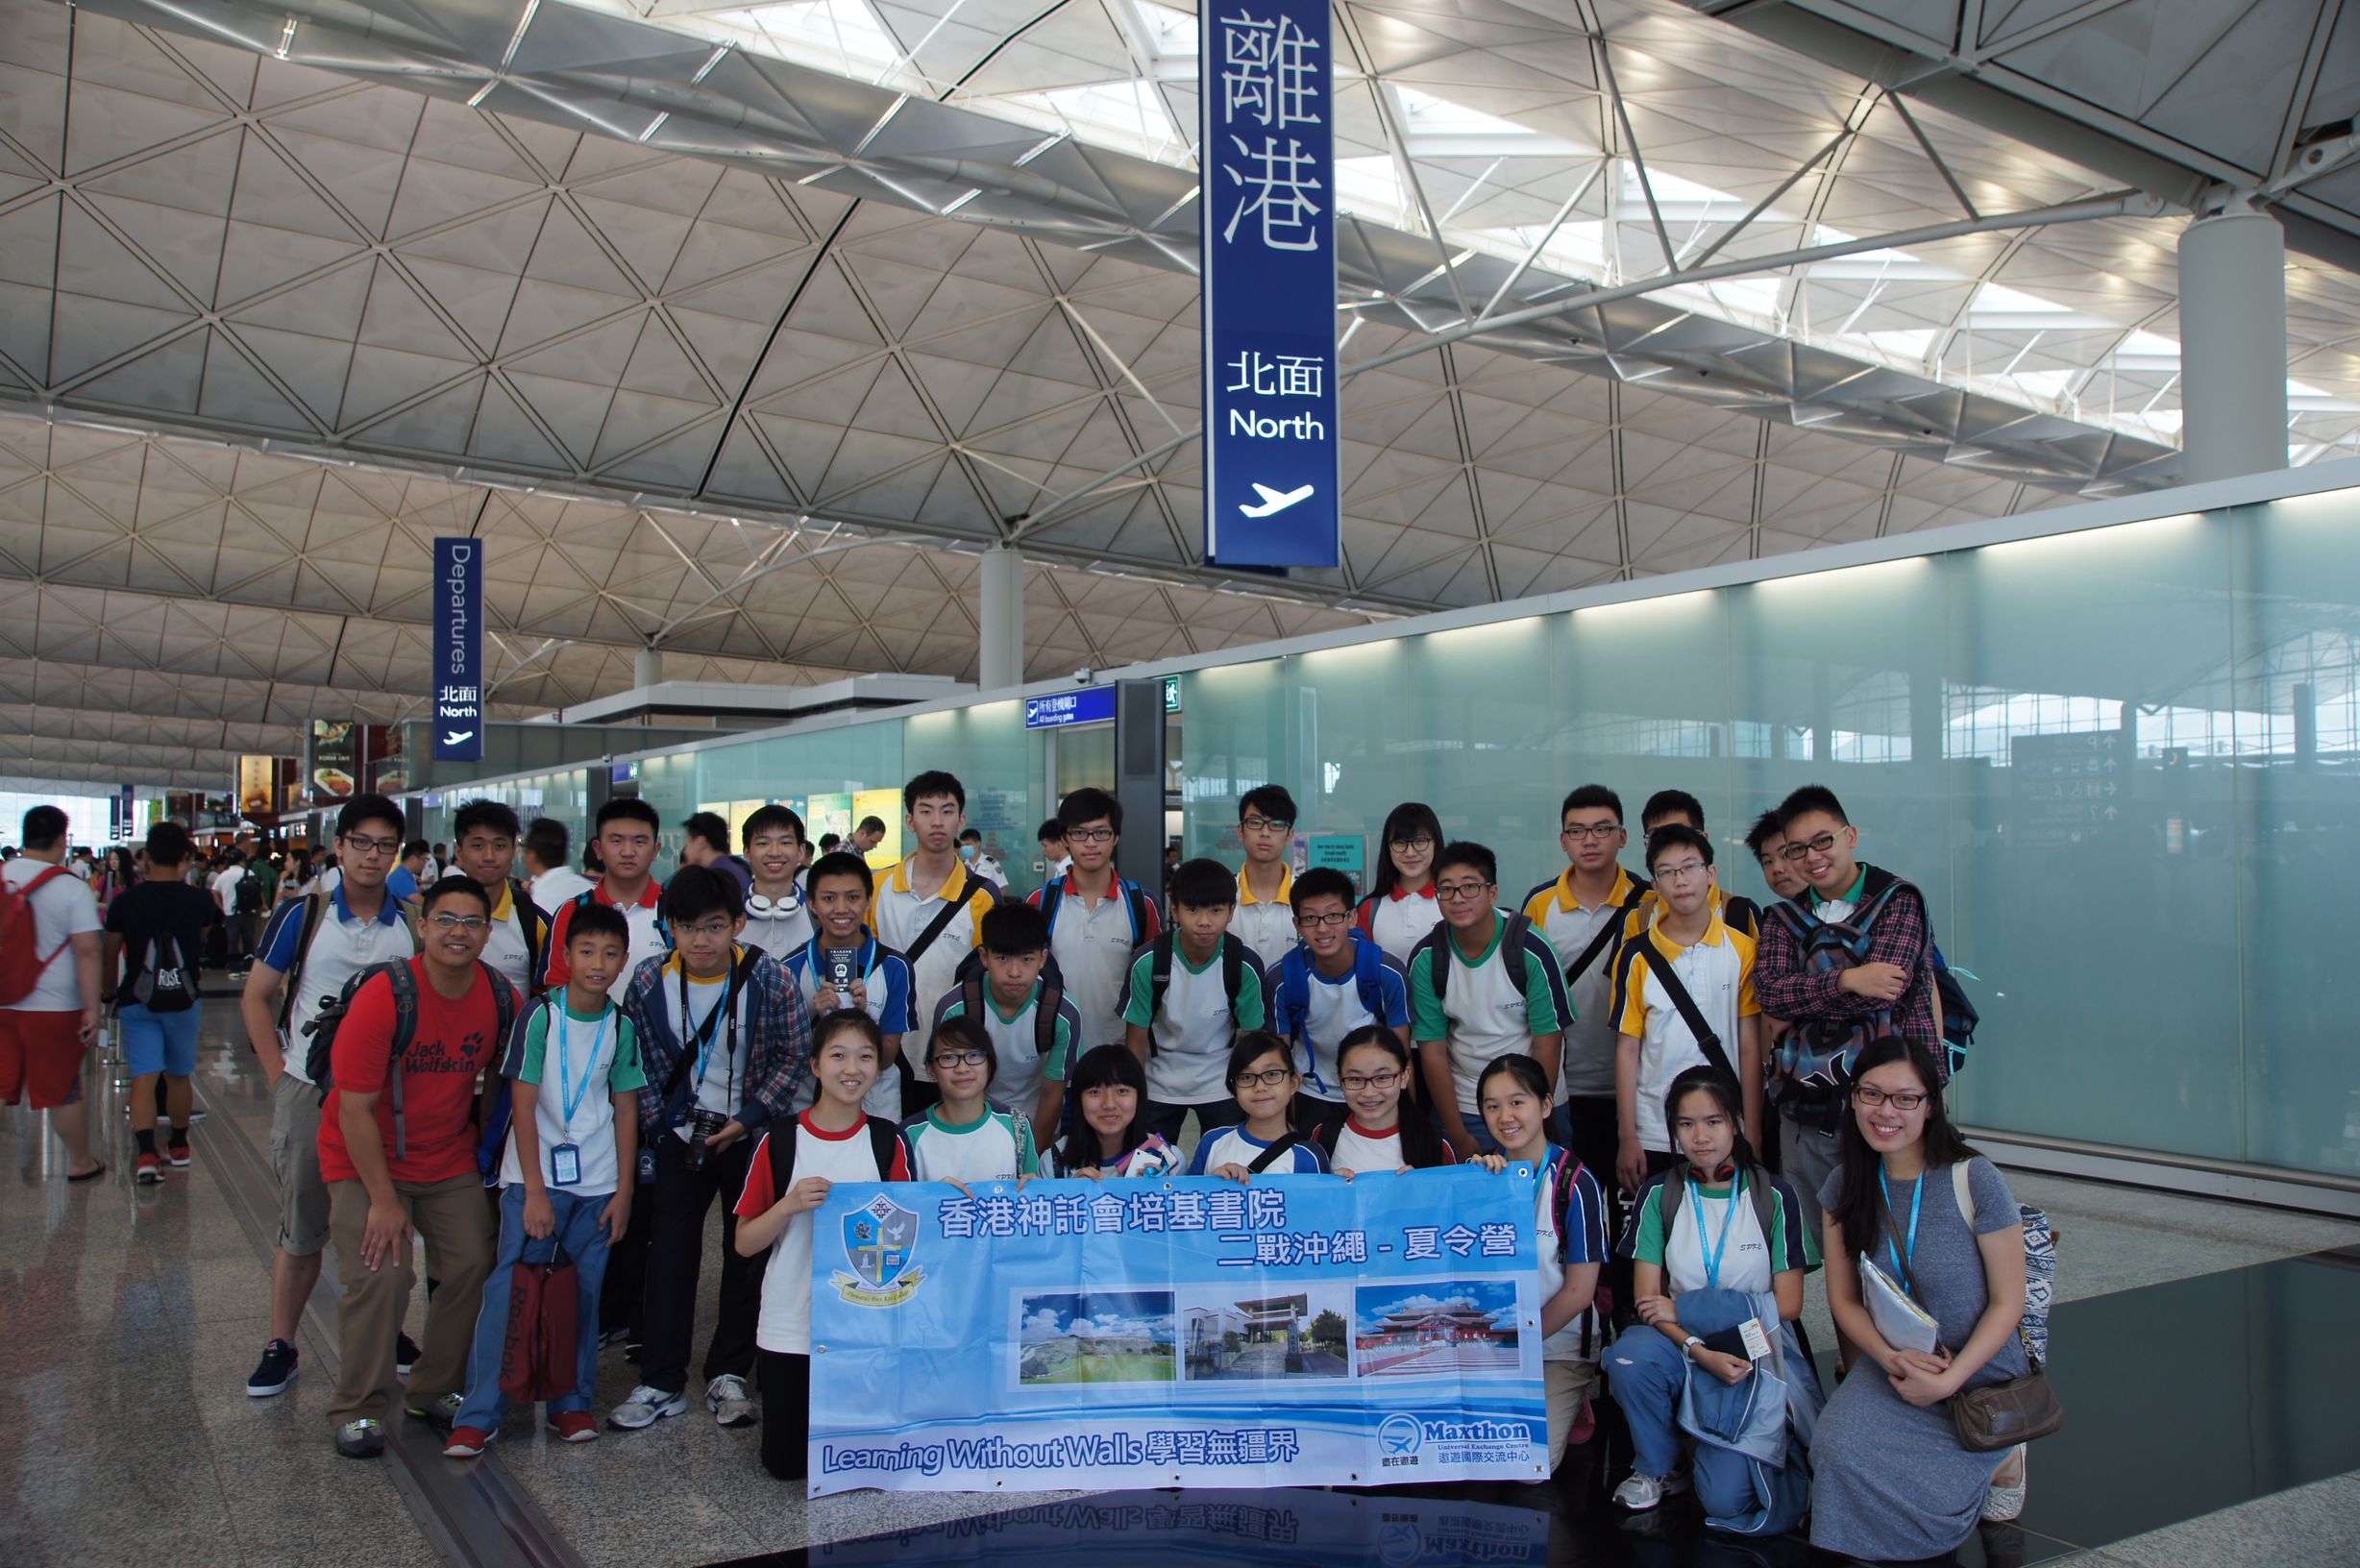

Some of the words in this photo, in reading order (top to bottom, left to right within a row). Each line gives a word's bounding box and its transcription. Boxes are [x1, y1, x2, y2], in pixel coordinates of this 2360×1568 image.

[1220, 9, 1321, 252] 離港
[1226, 351, 1323, 398] 北面
[1230, 409, 1324, 441] North
[447, 545, 471, 674] Departures
[439, 685, 477, 702] 北面
[440, 706, 477, 718] North
[406, 1057, 475, 1073] Wolfskin
[407, 1041, 446, 1056] Jack
[939, 1188, 1286, 1237] 香港神託會培基書院
[1217, 1230, 1367, 1266] 二戰沖繩
[1403, 1223, 1516, 1261] 夏令營
[1536, 1229, 1554, 1237] PKC
[499, 1286, 528, 1384] Reebok
[1424, 1420, 1530, 1441] Maxthon
[823, 1442, 945, 1475] Learning
[946, 1436, 1064, 1469] Without
[1066, 1432, 1143, 1467] Walls
[1145, 1429, 1298, 1466] 學習無疆界
